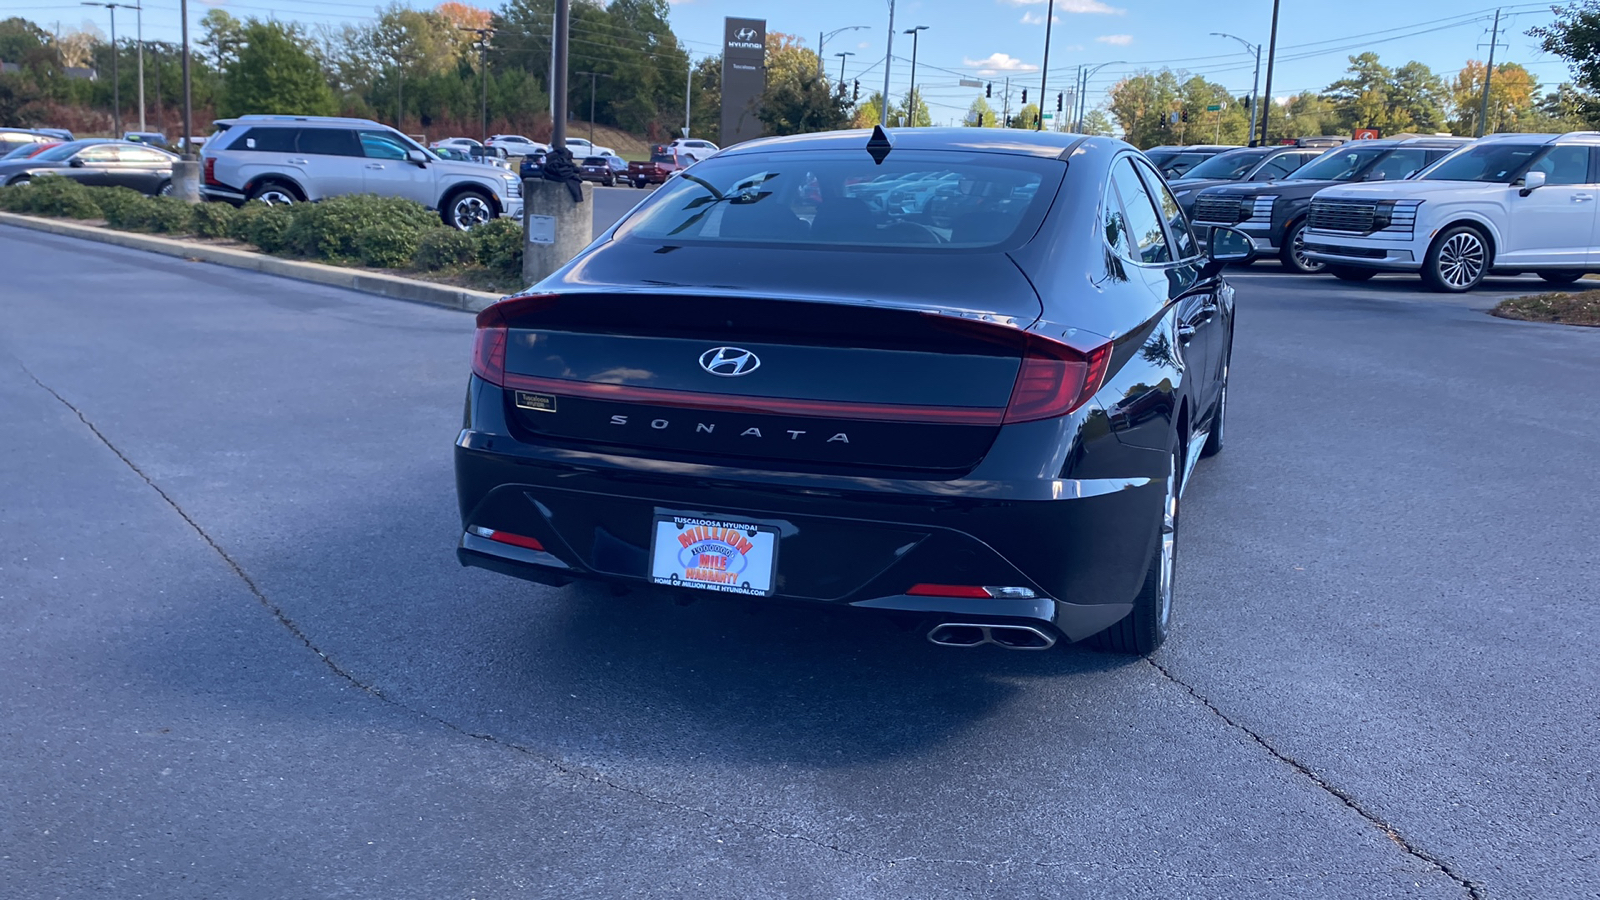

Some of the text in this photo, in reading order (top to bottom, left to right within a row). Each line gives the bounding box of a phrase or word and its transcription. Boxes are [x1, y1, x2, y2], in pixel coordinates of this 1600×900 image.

[728, 41, 762, 49] HYUNDAI
[610, 415, 849, 443] SONATA
[674, 517, 758, 531] TUSCALOOSA HYUNDAI
[678, 526, 753, 555] MILLION
[699, 554, 727, 571] MILE
[686, 568, 739, 584] WARRANTY
[654, 578, 672, 586] HOME
[721, 586, 765, 596] HYUNDAI.COM
